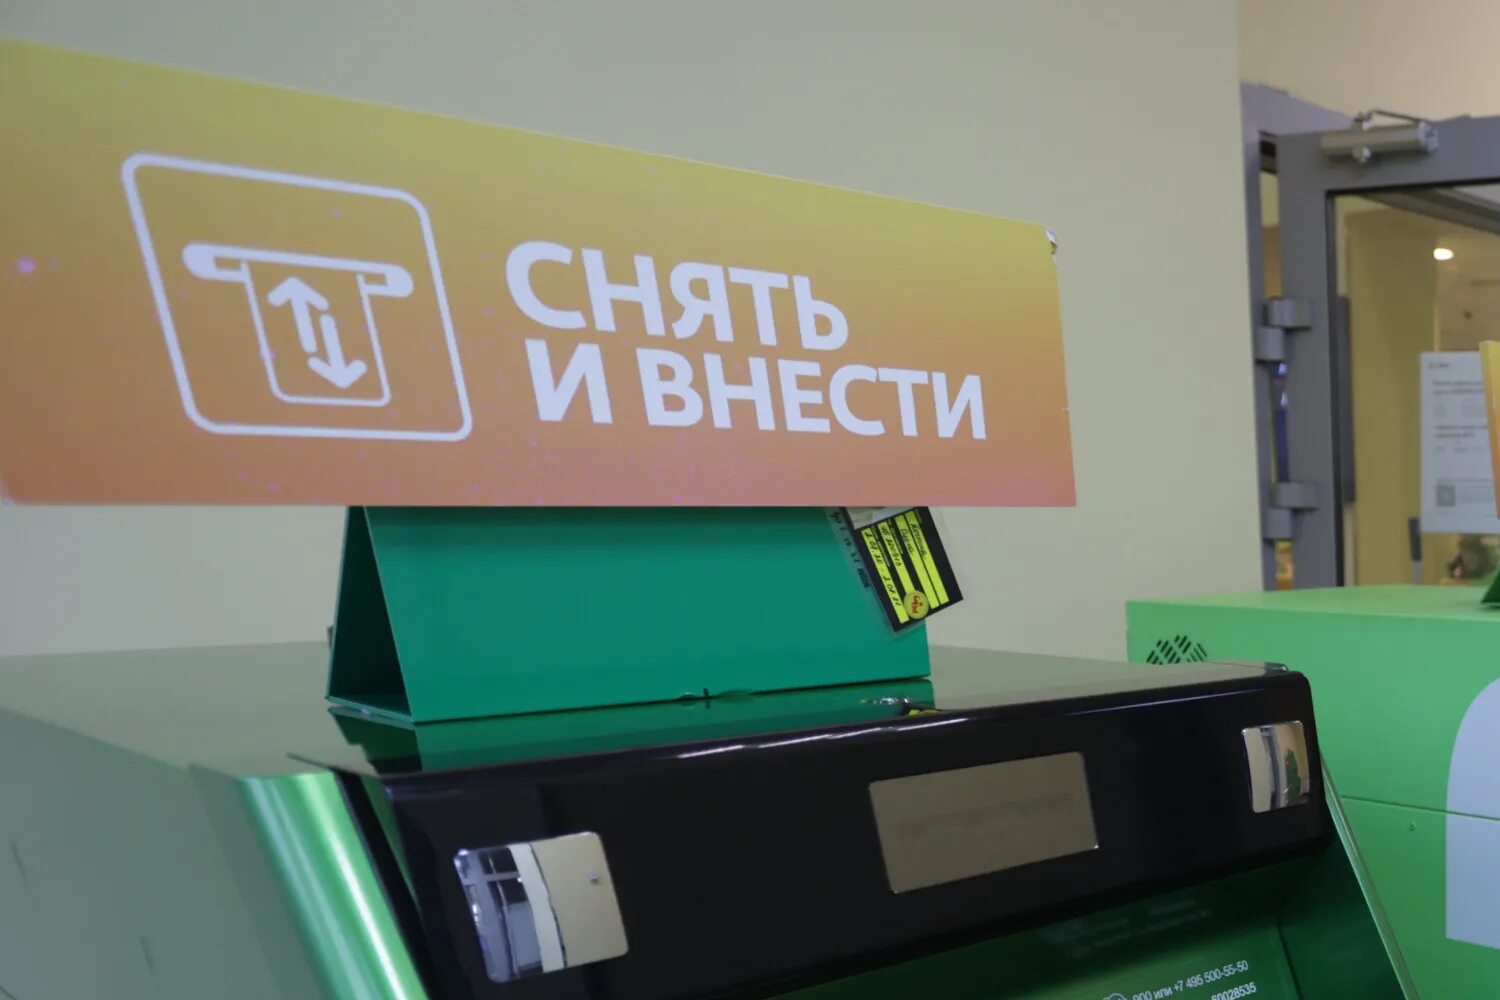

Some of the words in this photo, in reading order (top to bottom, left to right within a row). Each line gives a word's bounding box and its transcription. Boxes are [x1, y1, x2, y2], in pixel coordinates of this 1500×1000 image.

[504, 240, 849, 351] СНЯТЬ
[525, 337, 612, 425] И
[636, 348, 987, 440] ВНЕСТИ
[1154, 987, 1173, 1000] или
[1174, 981, 1184, 993] +7
[1186, 975, 1203, 988] 495
[1204, 960, 1249, 984] 500-55-50
